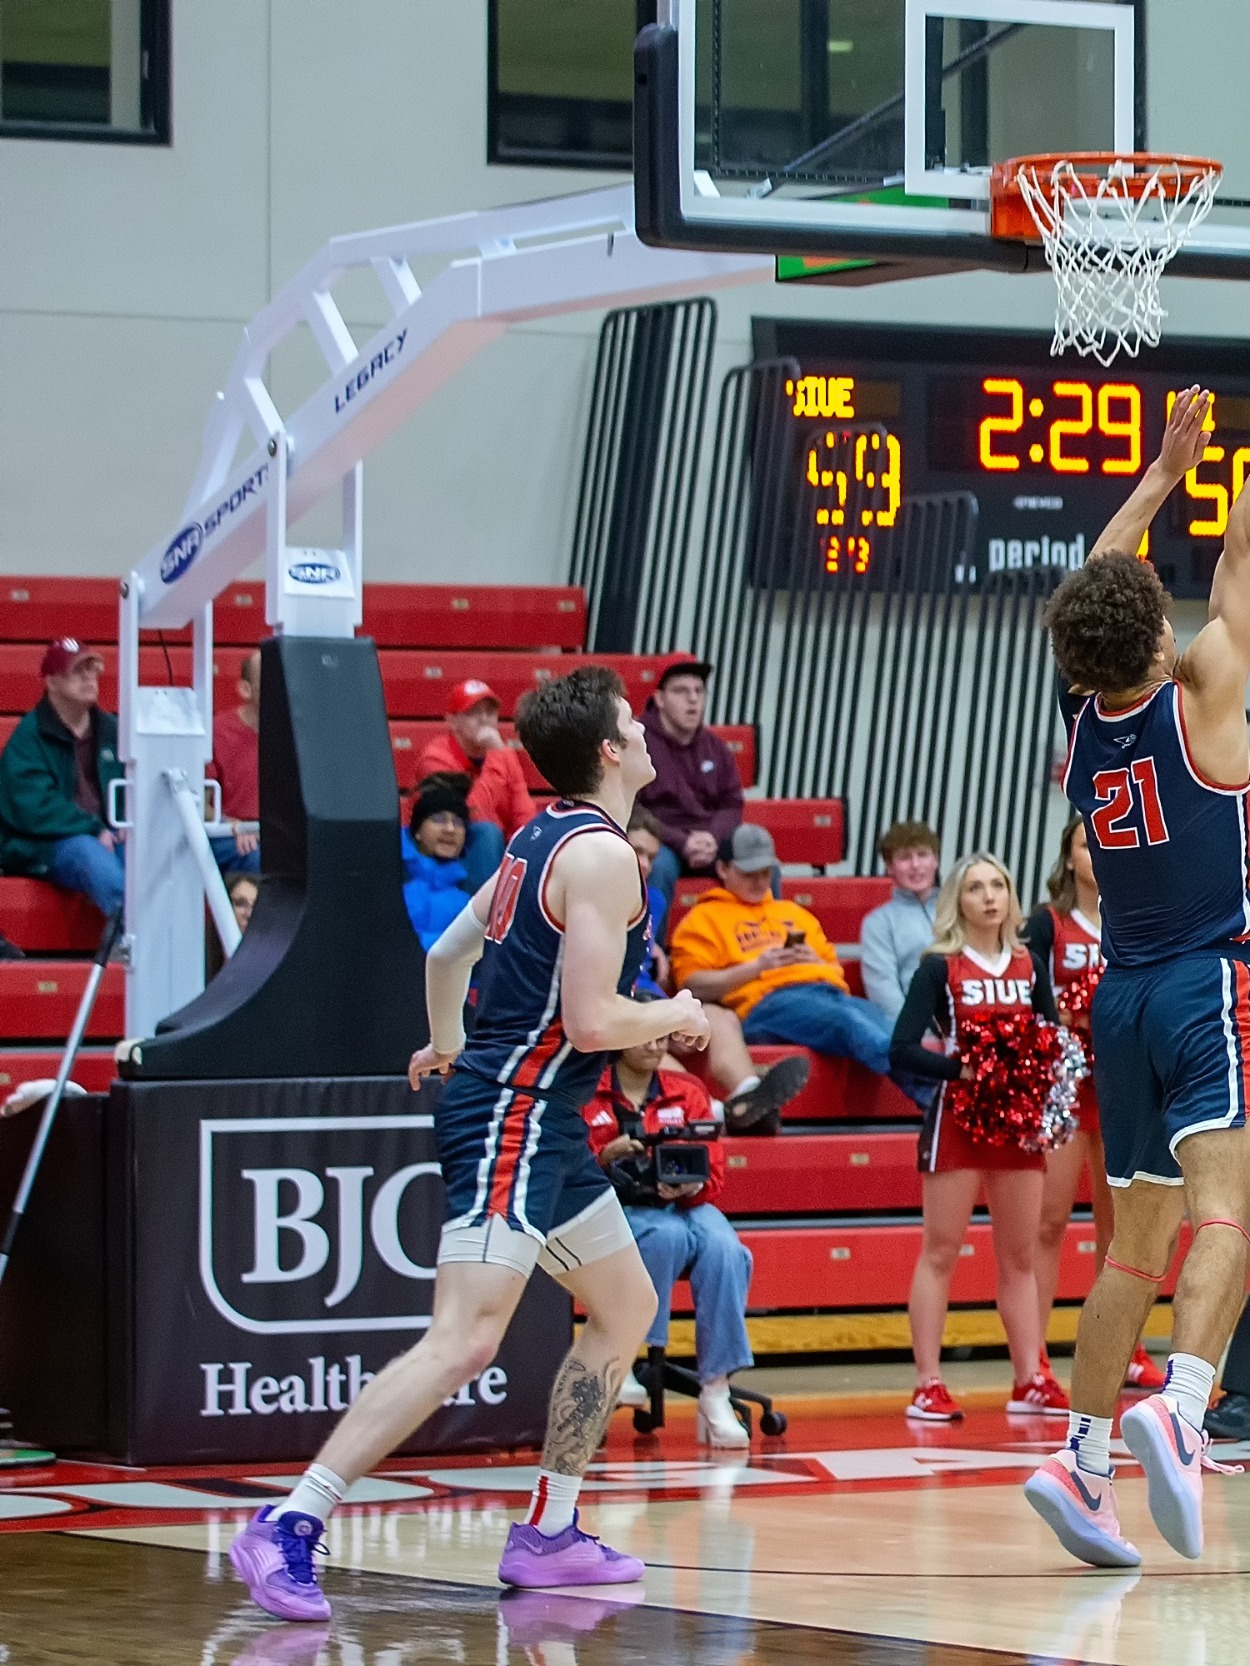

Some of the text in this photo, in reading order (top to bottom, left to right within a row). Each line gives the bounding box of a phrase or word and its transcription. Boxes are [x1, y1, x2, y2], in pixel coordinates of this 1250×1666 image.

[334, 327, 408, 415] LEGACY
[978, 379, 1142, 474] 2:29
[160, 463, 269, 580] SNR SPORT
[291, 564, 339, 584] SNR
[1091, 755, 1171, 849] 21
[484, 852, 528, 945] 10
[961, 978, 1032, 1006] SIUE
[240, 1162, 443, 1308] BJC
